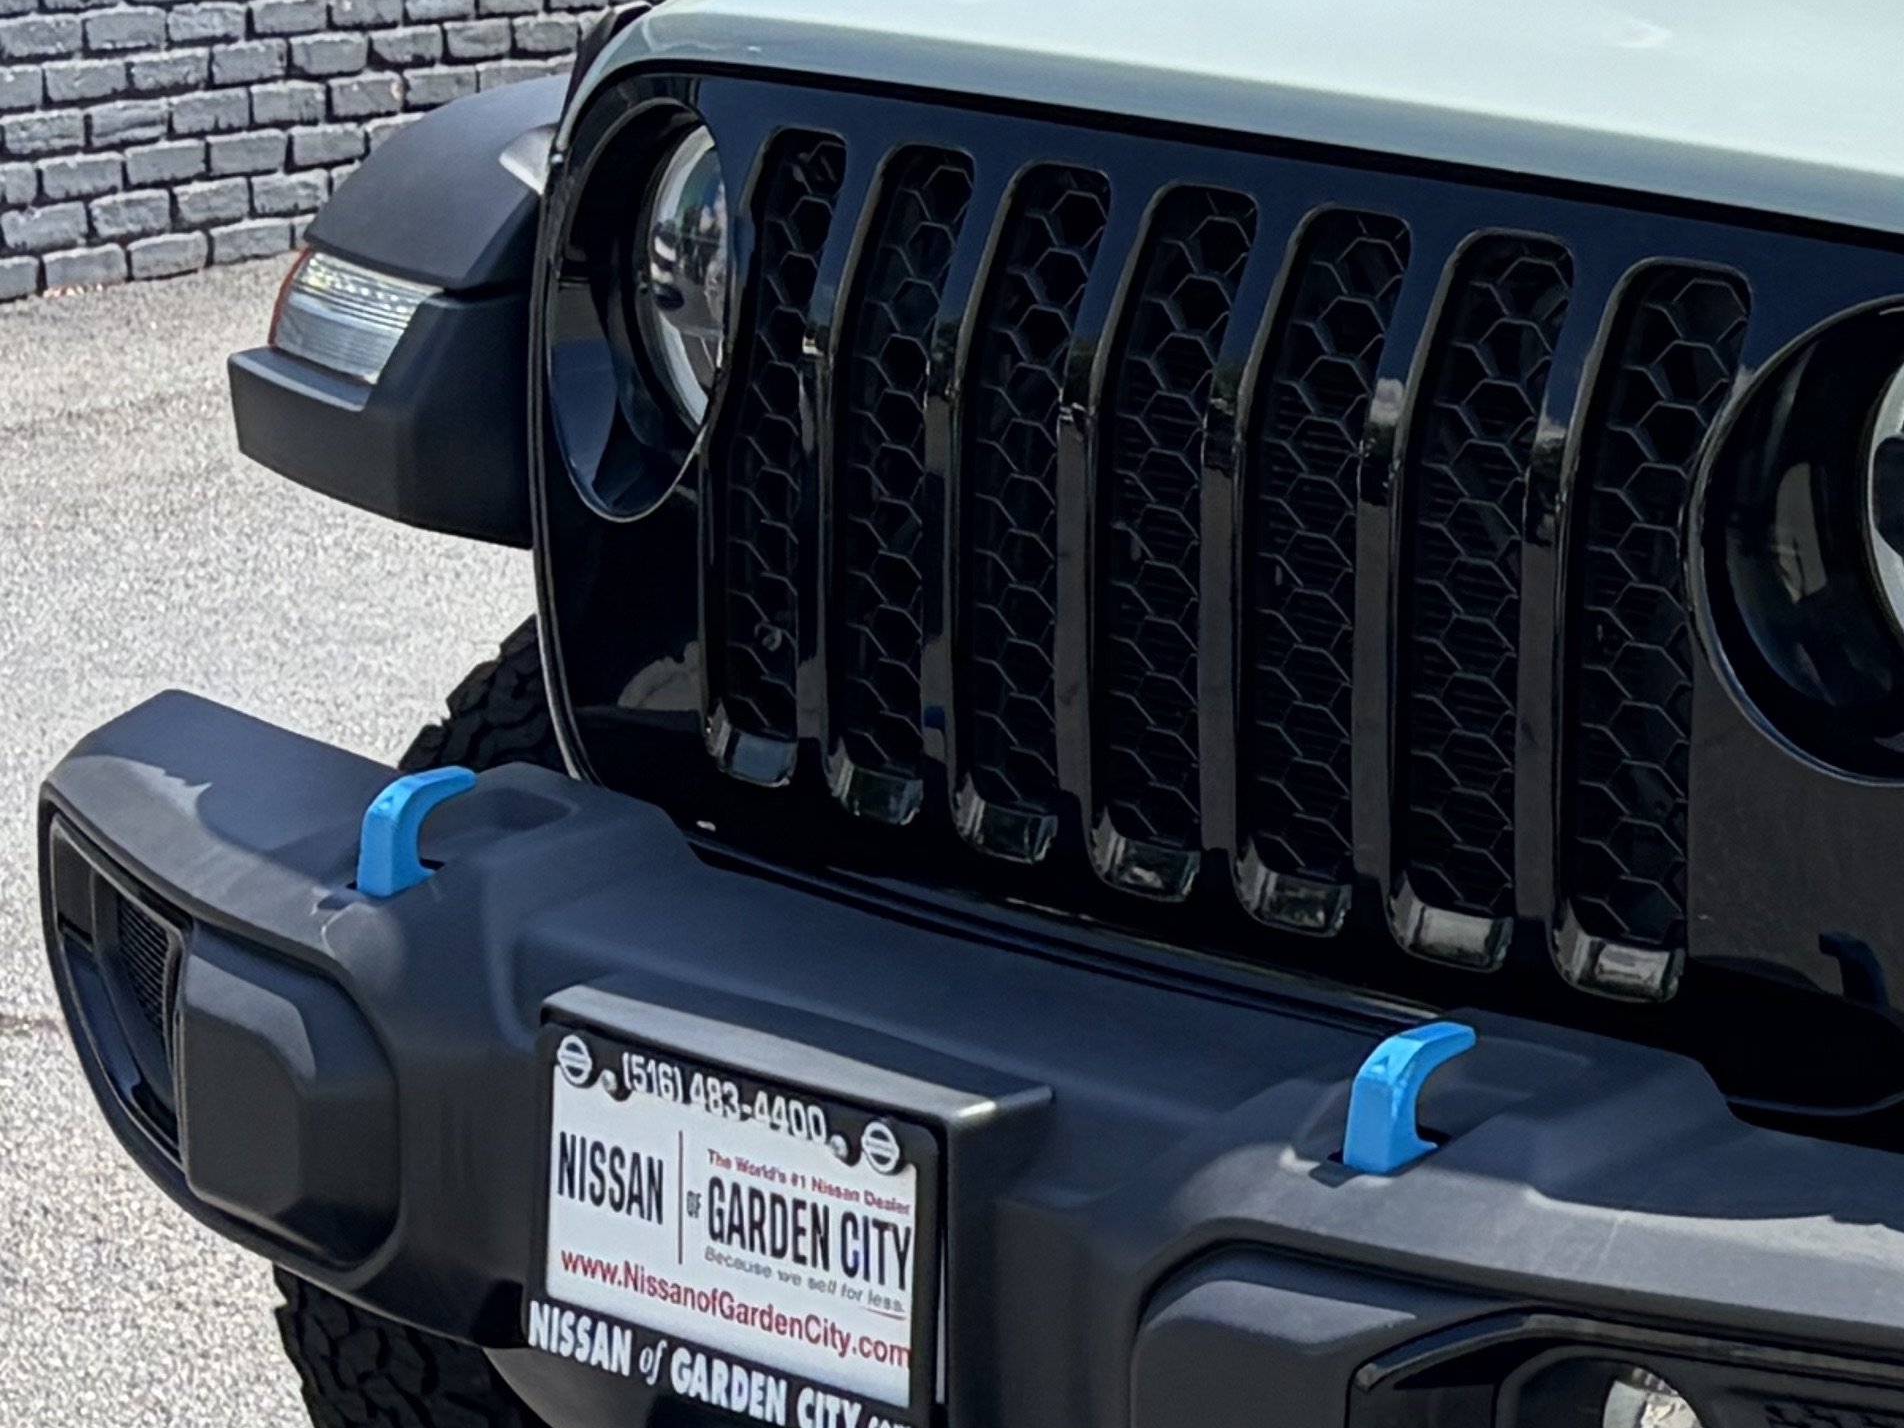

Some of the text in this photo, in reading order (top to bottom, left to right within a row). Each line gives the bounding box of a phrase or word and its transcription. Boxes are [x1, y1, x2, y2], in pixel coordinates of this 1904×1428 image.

[623, 1051, 828, 1141] (516) 483-4400
[557, 1130, 664, 1225] NISSAN
[707, 1148, 731, 1169] The
[735, 1156, 786, 1183] World's
[811, 1176, 860, 1202] Nissan
[864, 1190, 910, 1215] Dealer
[705, 1246, 772, 1278] Because
[778, 1270, 802, 1287] we
[808, 1277, 837, 1295] sell
[841, 1283, 863, 1302] for
[708, 1175, 911, 1291] GARDEN CITY
[561, 1249, 911, 1369] www.NissanofGardenCity.com
[528, 1301, 632, 1376] NISSAN
[639, 1339, 663, 1386] of
[671, 1350, 786, 1427] GARDEN
